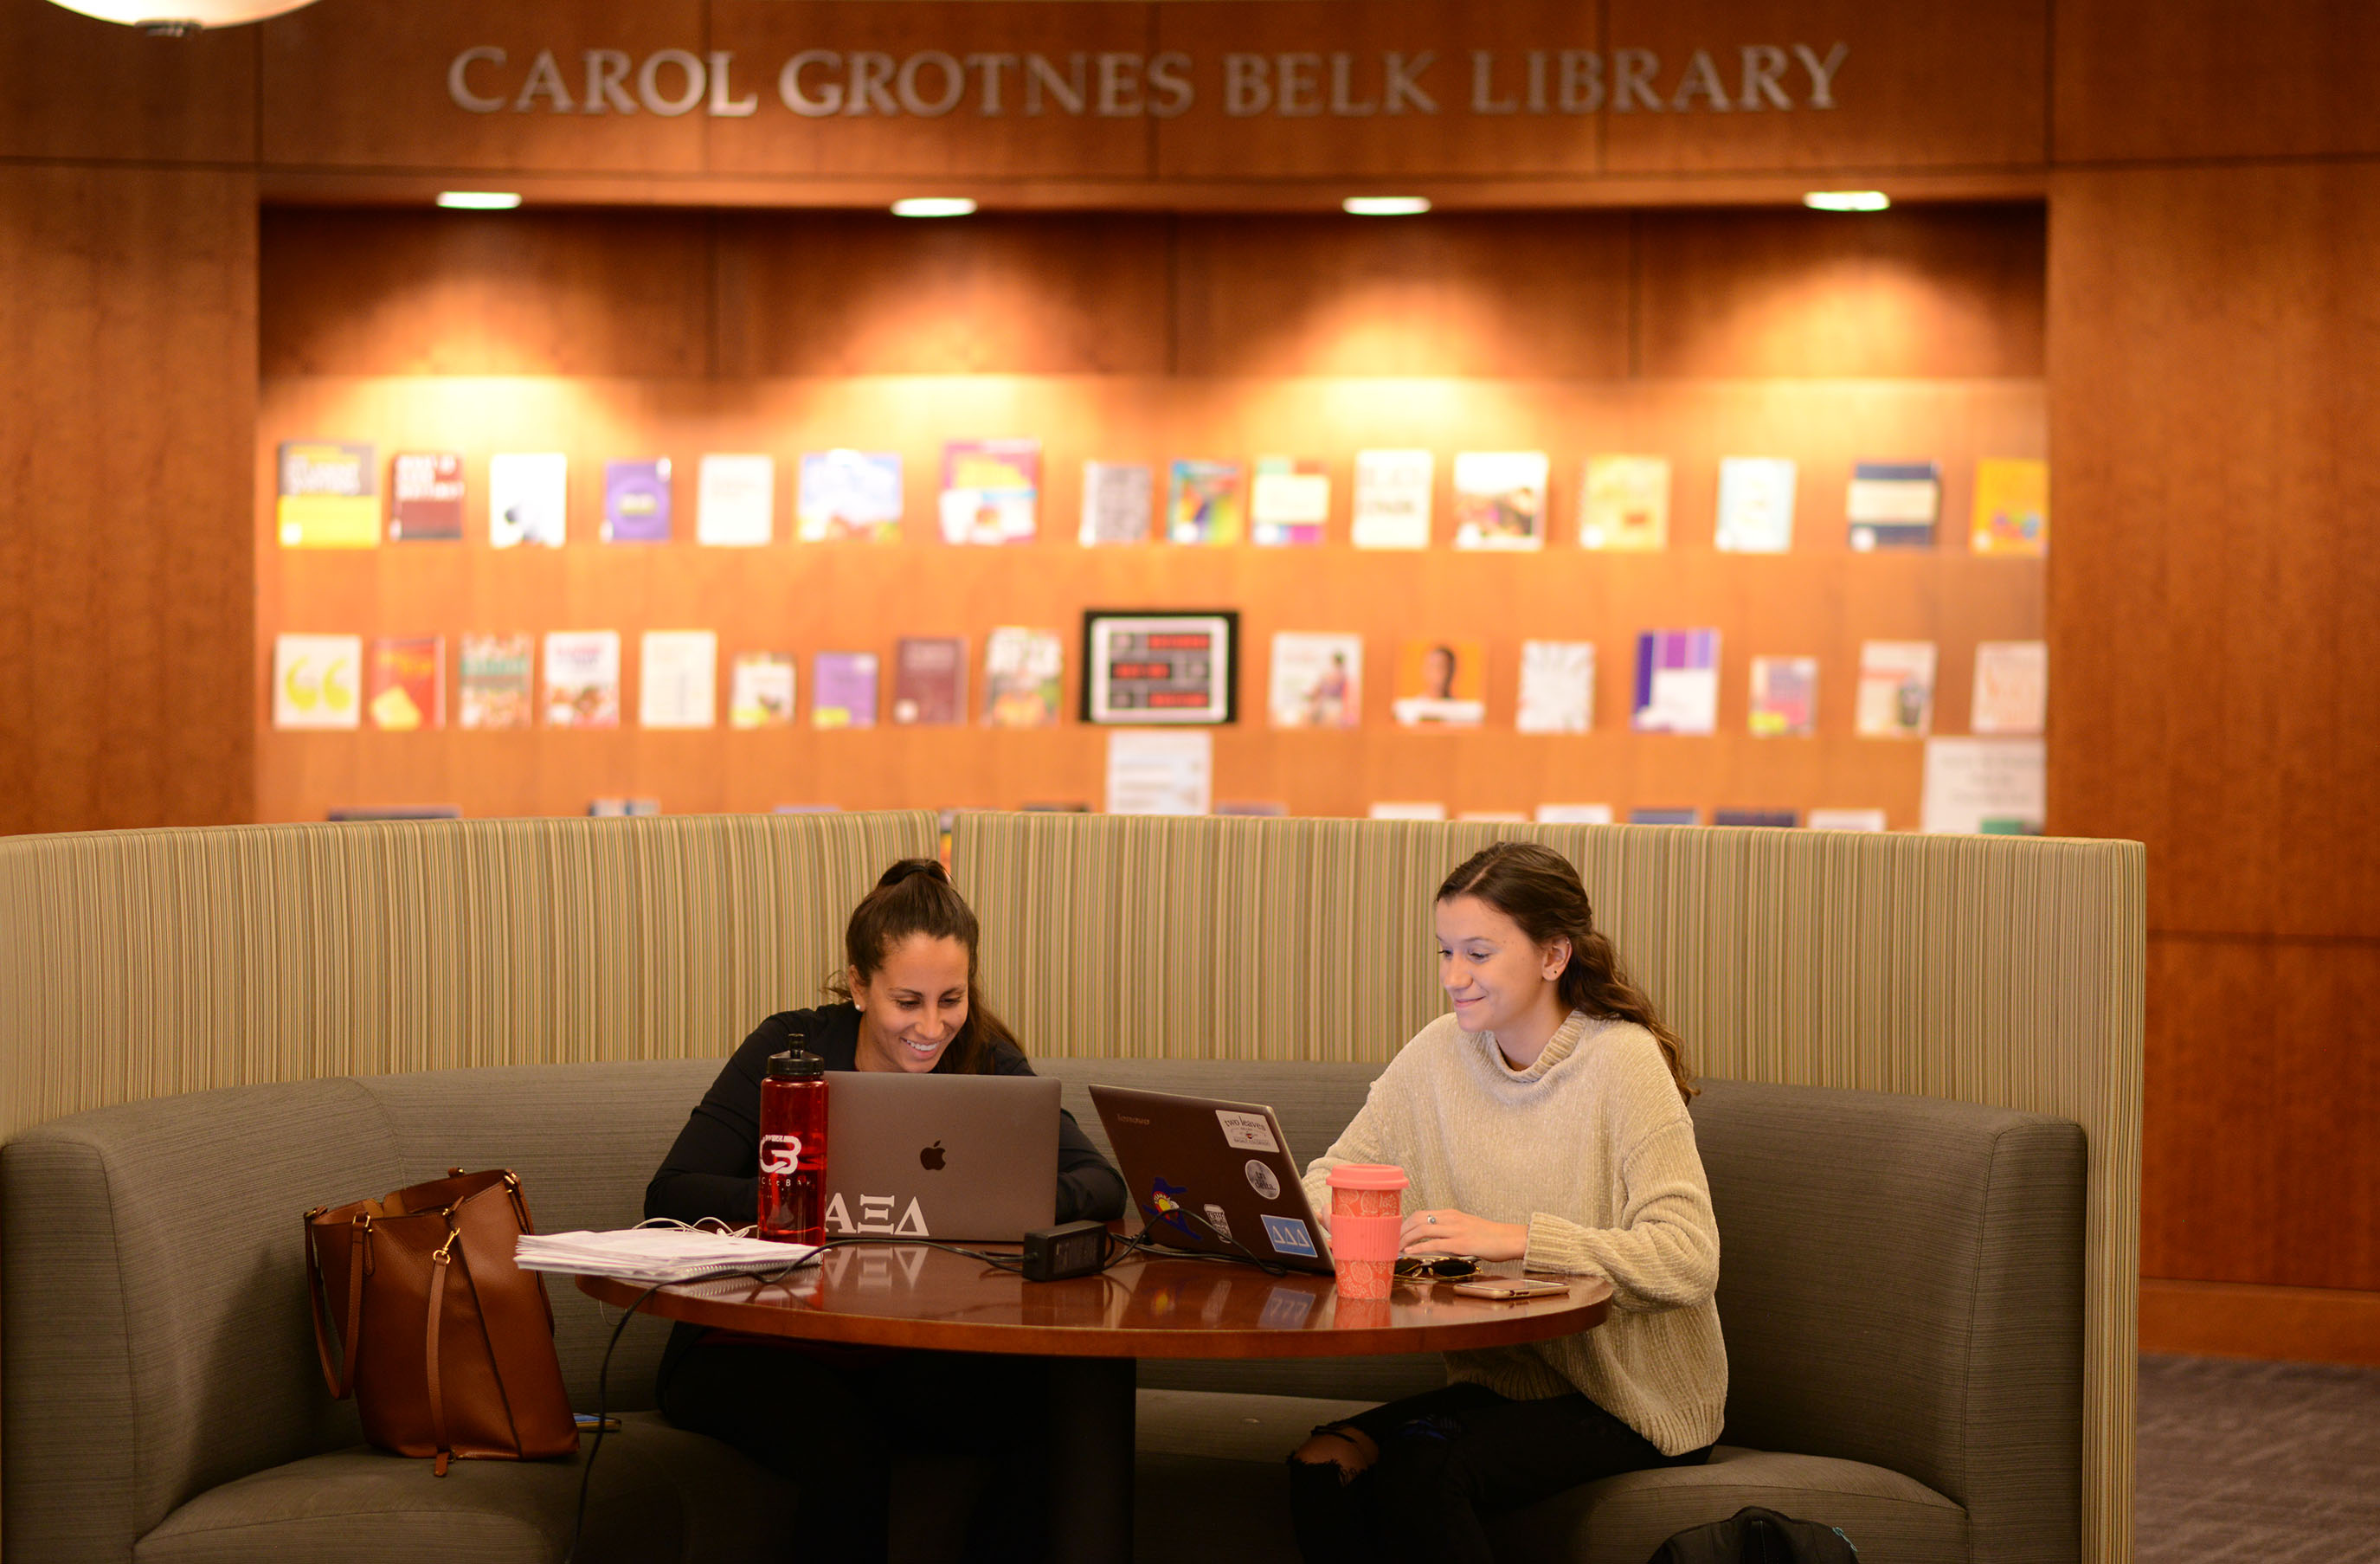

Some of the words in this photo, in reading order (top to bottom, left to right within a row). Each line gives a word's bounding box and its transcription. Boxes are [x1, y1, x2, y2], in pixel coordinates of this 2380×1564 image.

[447, 45, 759, 117] CAROL
[779, 48, 1193, 118] GROTNES
[1223, 49, 1438, 118] BELK
[1471, 41, 1849, 115] LIBRARY
[1238, 1115, 1266, 1131] leaves
